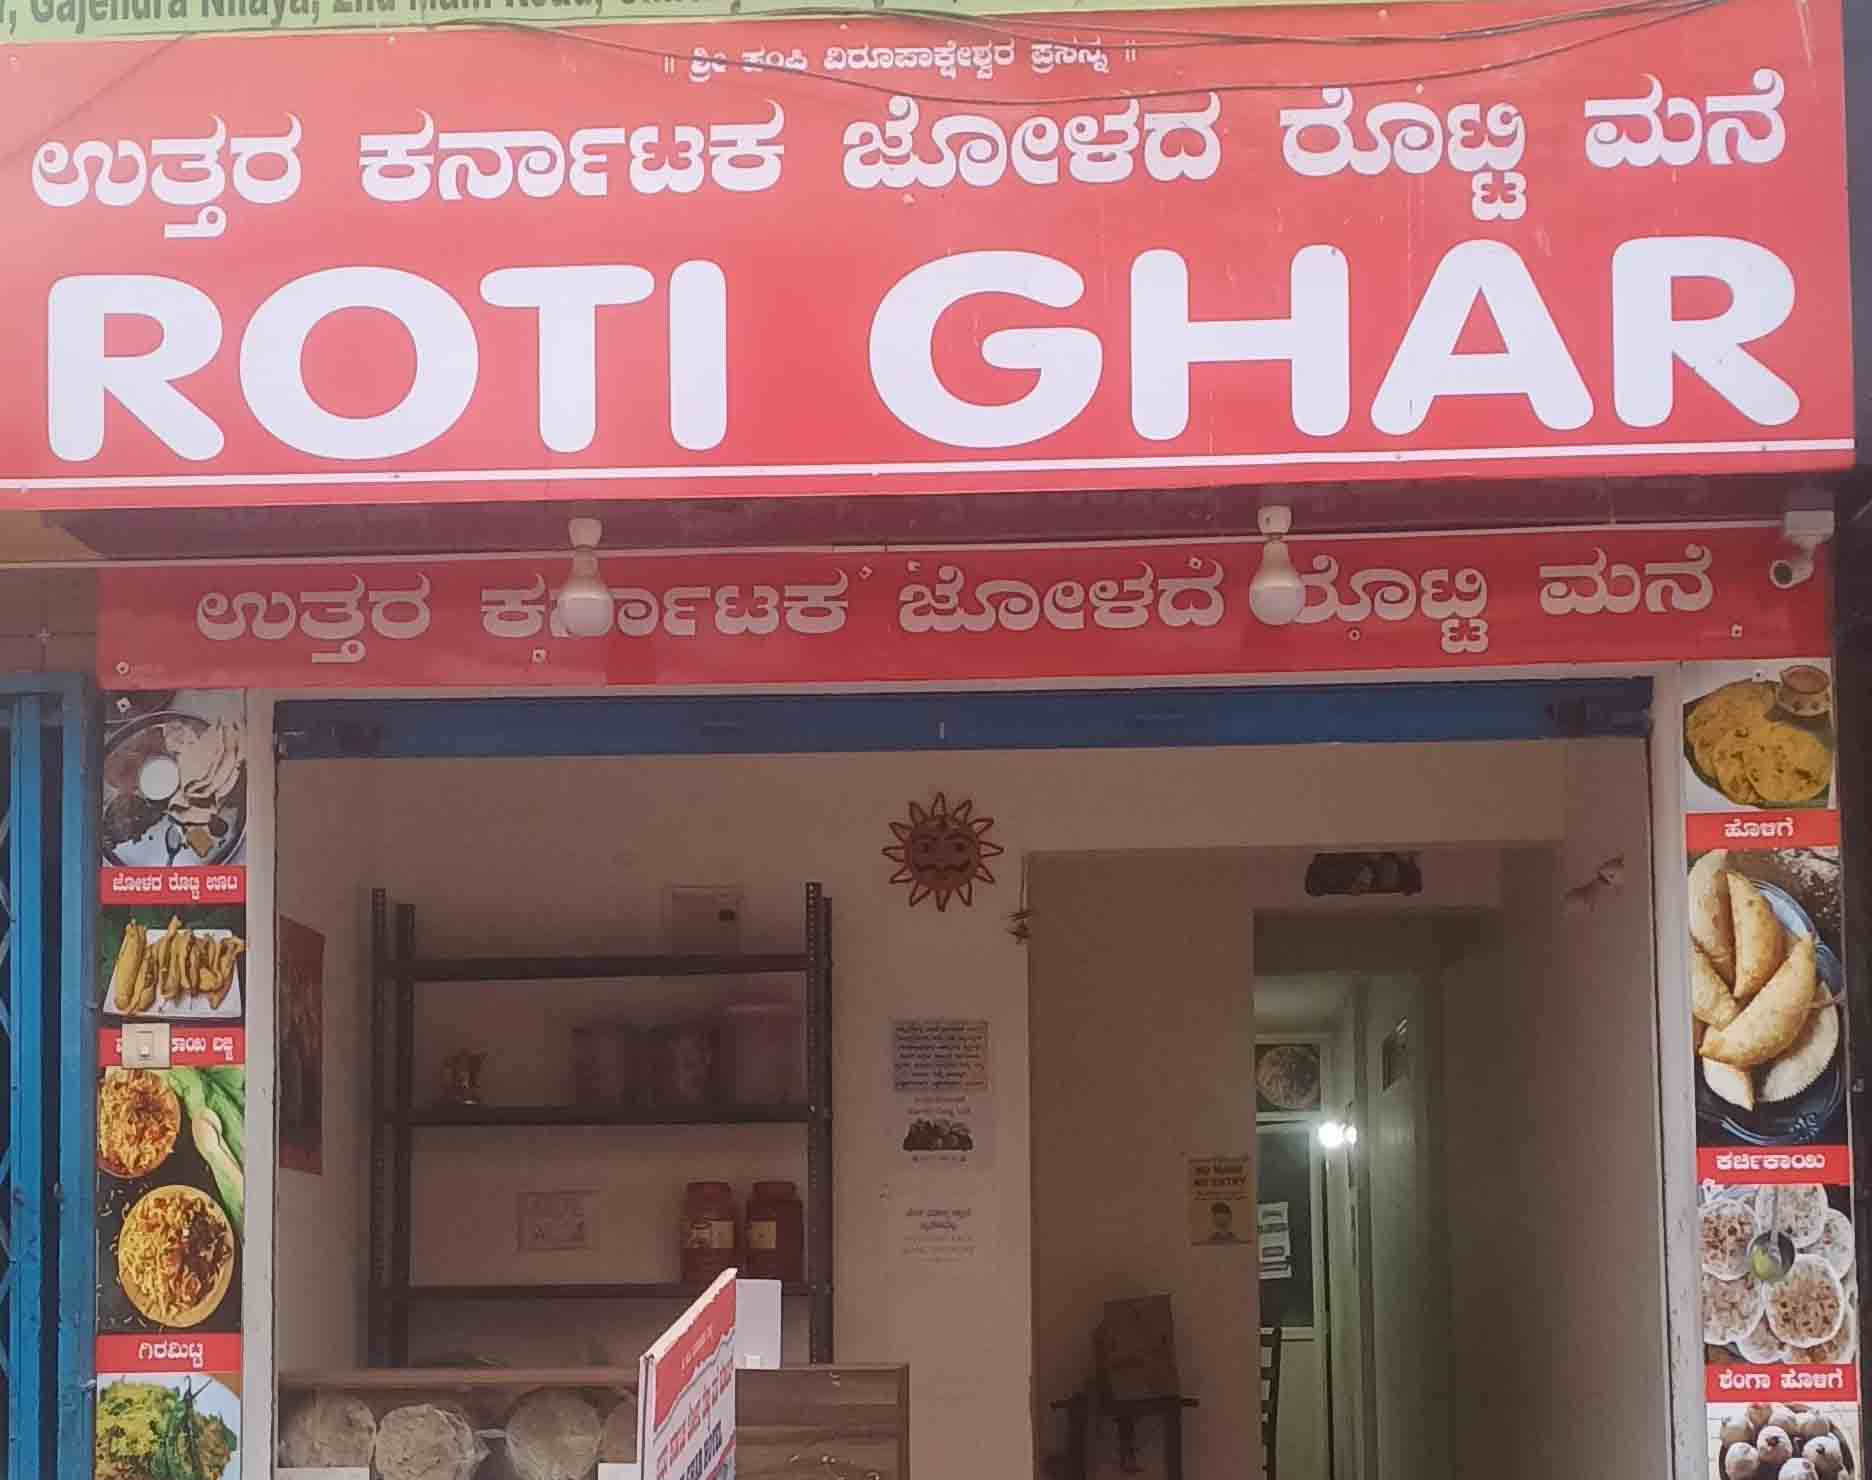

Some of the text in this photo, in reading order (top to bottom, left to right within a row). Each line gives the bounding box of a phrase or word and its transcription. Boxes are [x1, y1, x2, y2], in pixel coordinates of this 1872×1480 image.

[32, 68, 1786, 239] ಉತ್ತರ ಕರ್ನಾಟಕ ಜೋಳದ ರೊಟ್ಟಿ ಮನೆ
[48, 235, 1801, 462] ROTI GHAR
[196, 572, 432, 665] ಉತ್ತರ
[898, 559, 1224, 632] ಜೋಳದ
[1540, 544, 1714, 615] ಮನೆ
